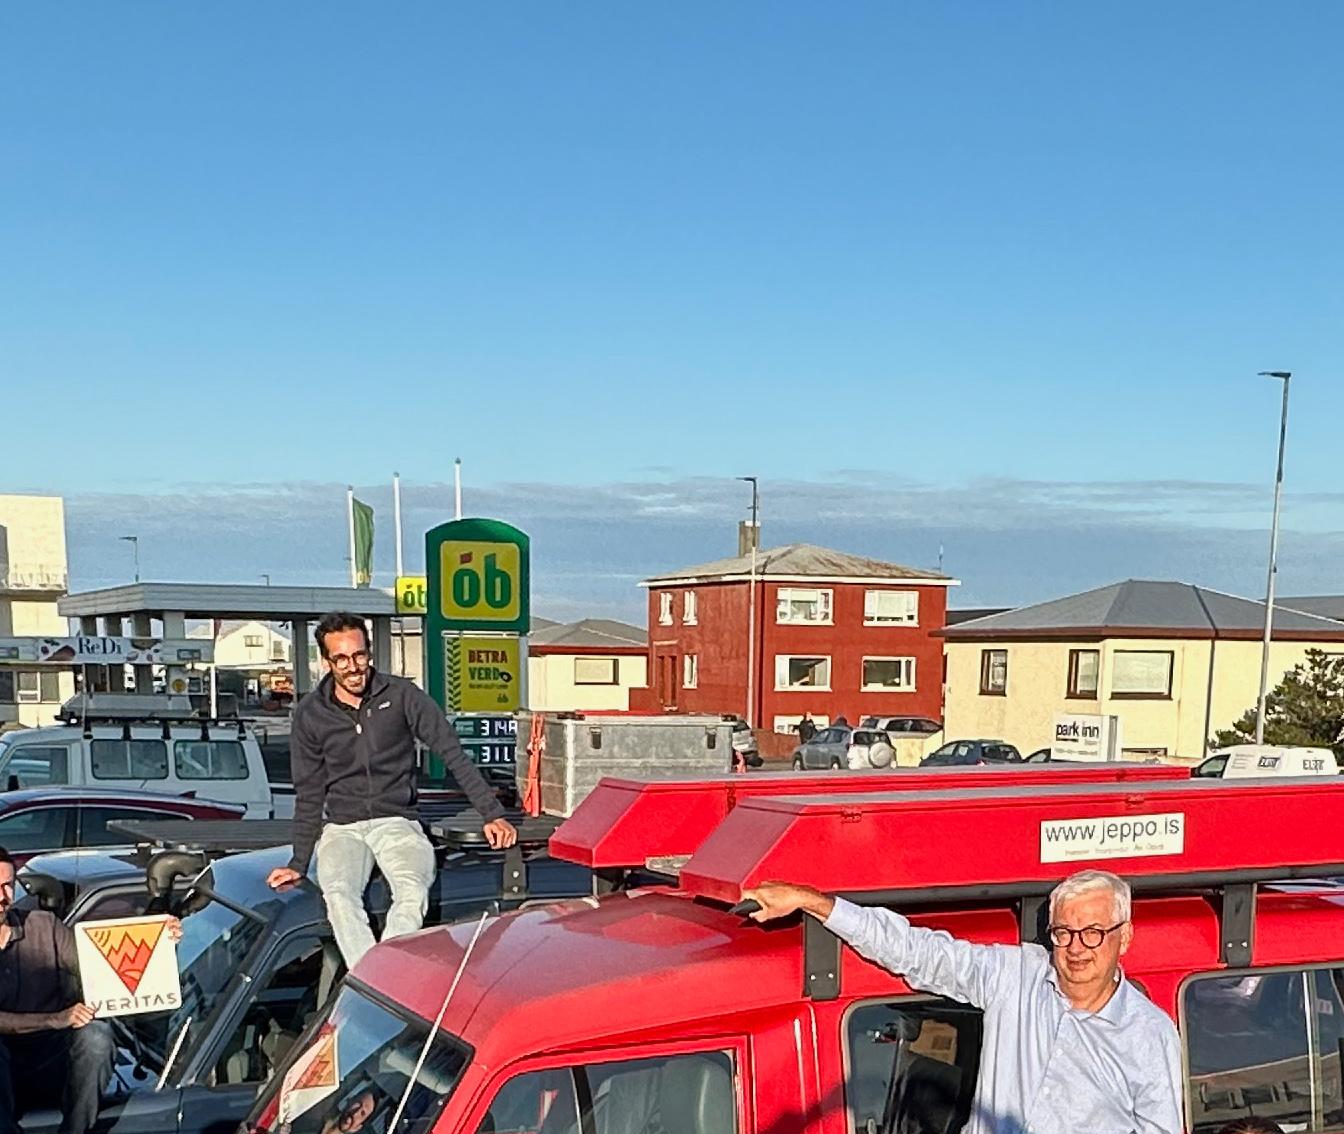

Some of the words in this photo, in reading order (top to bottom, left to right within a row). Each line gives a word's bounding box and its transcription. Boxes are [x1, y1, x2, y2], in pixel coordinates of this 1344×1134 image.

[78, 636, 122, 655] ReDi
[468, 650, 507, 663] BETRA
[1056, 721, 1079, 740] park
[1081, 721, 1099, 738] inn
[1045, 816, 1180, 845] www.jeppo.is
[91, 993, 178, 1013] VERITAS
